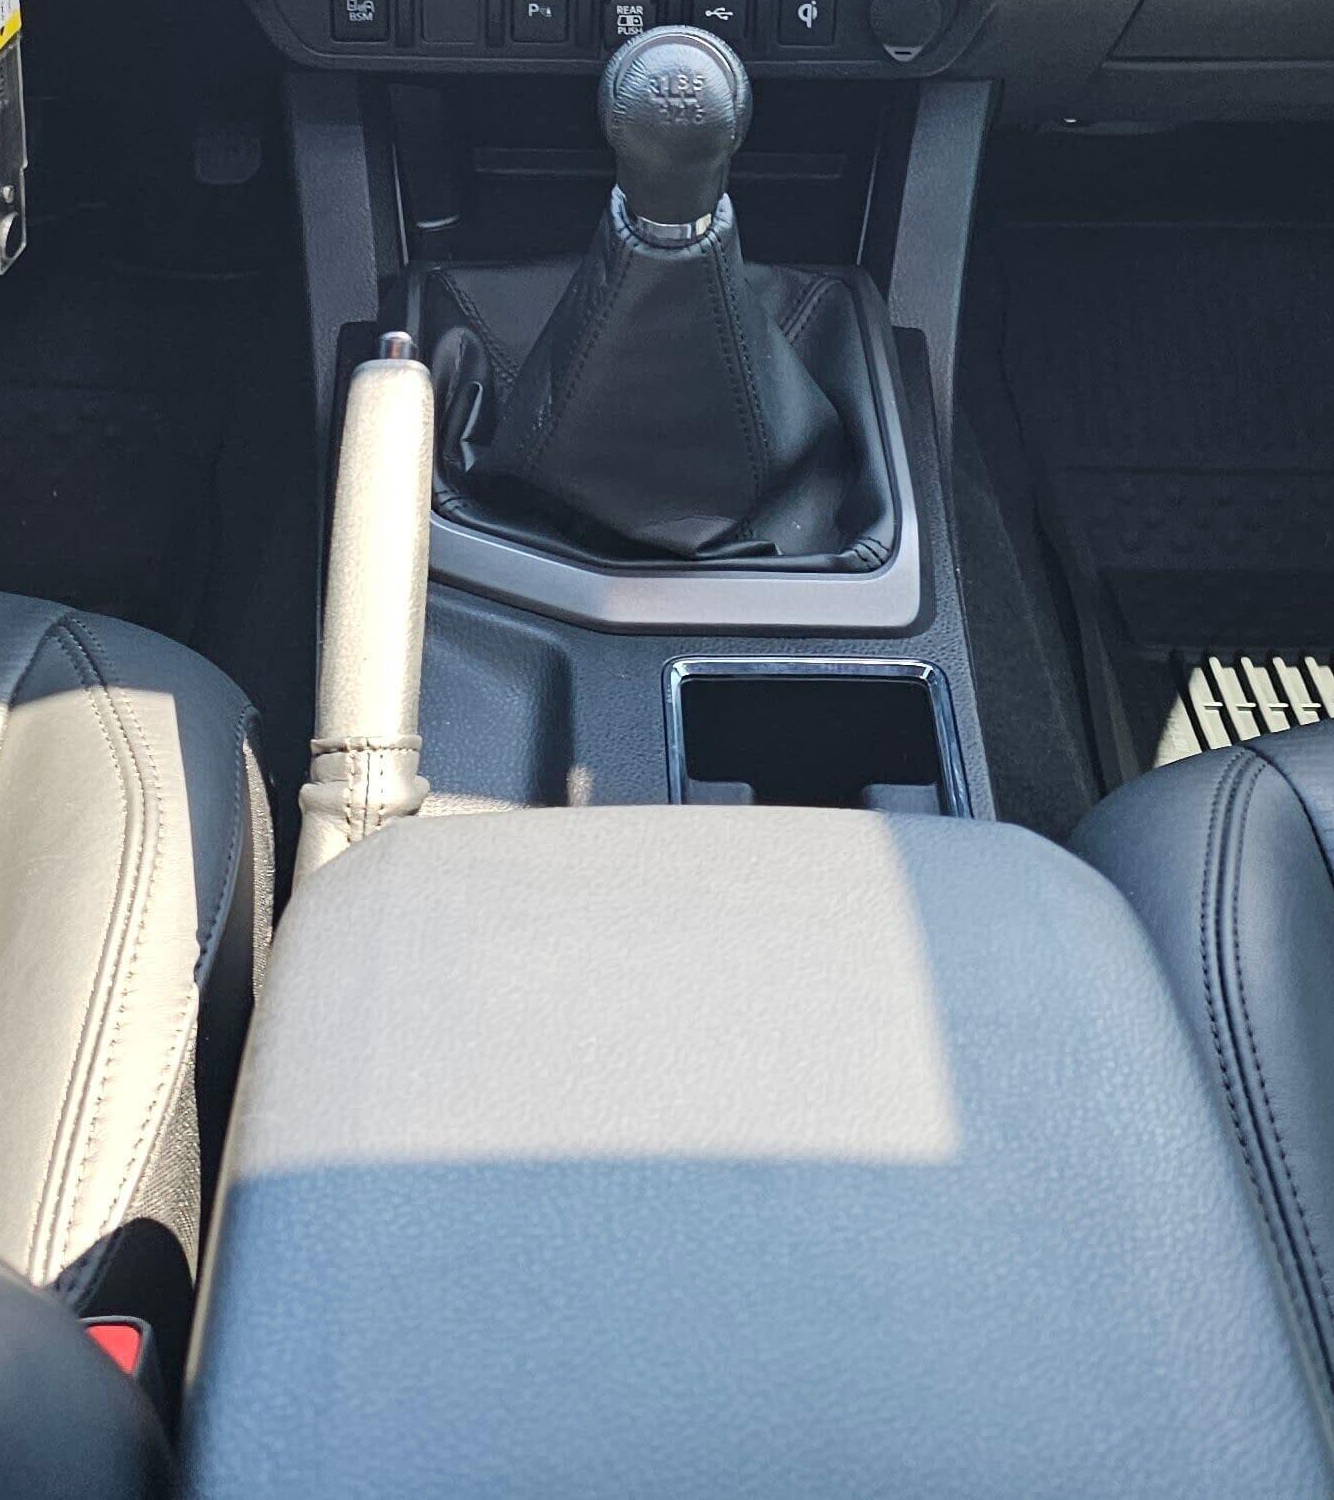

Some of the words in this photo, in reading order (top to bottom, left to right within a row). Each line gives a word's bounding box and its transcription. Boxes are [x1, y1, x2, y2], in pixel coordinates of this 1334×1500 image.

[616, 5, 644, 15] REAR
[348, 12, 374, 22] BSM
[617, 26, 644, 36] PUSH
